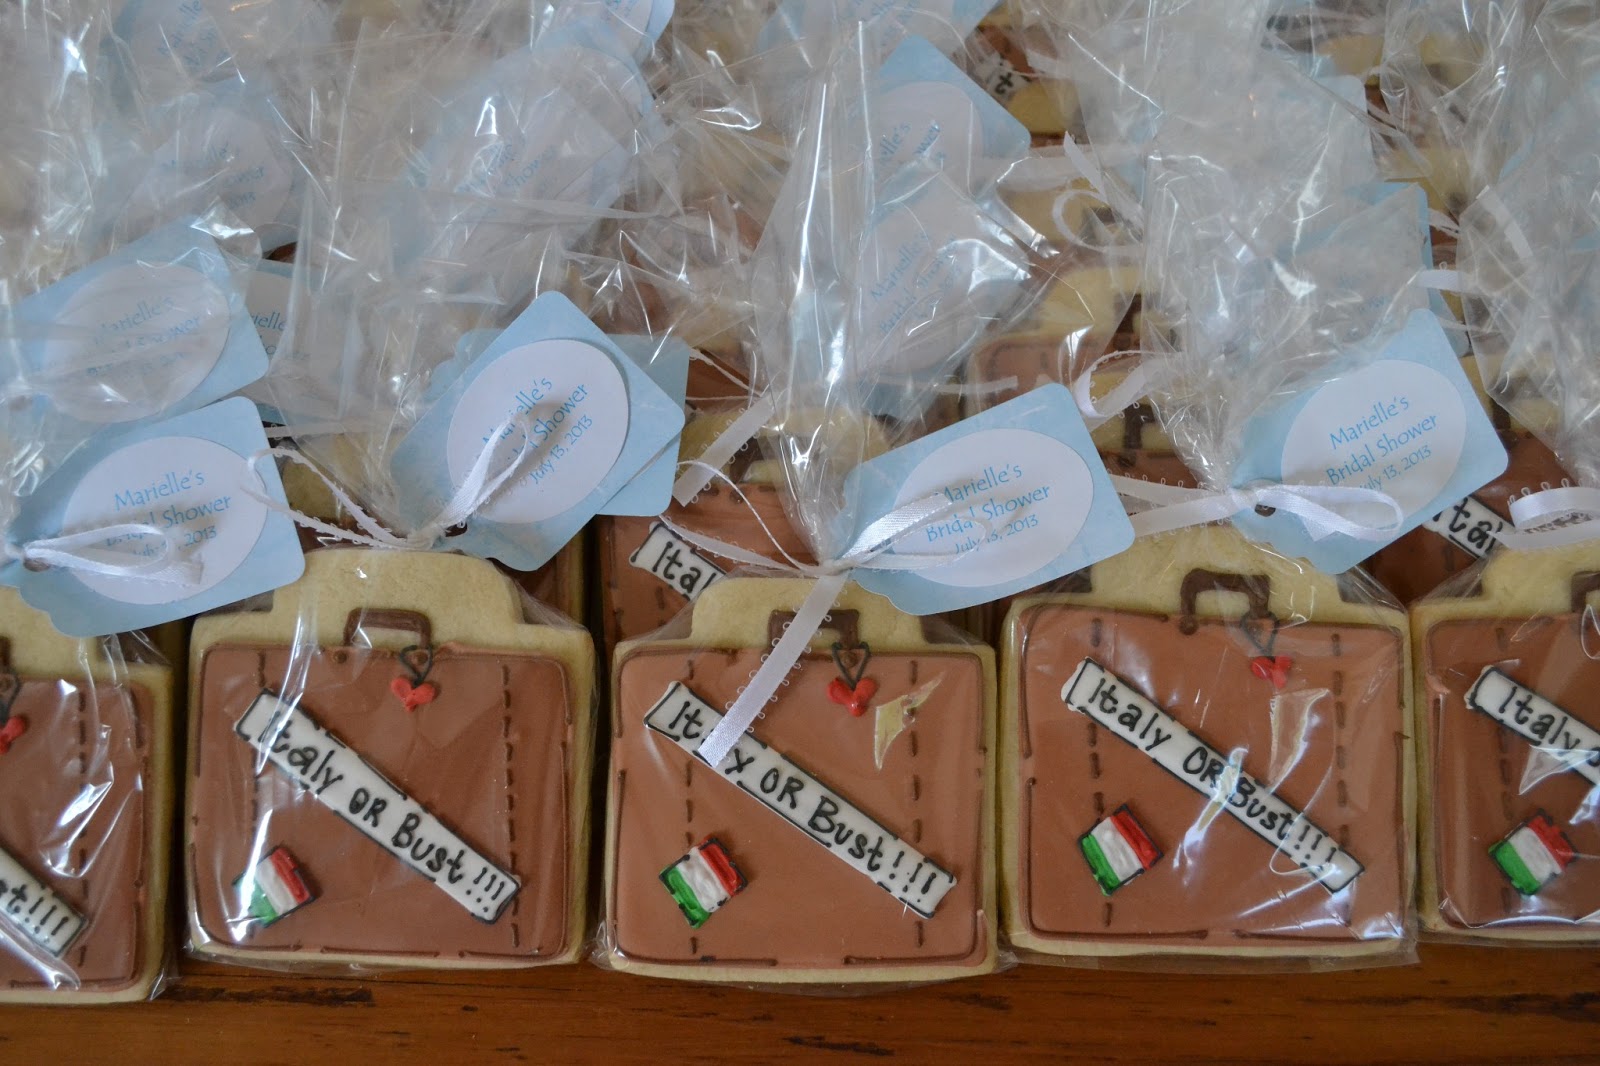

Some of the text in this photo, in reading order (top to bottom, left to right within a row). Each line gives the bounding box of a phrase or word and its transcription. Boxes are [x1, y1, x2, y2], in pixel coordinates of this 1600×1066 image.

[533, 383, 589, 442] Shower
[1329, 396, 1410, 450] Marielle's
[530, 457, 556, 485] July
[564, 414, 593, 446] 2013
[1325, 415, 1438, 486] Bridal Shower
[1358, 473, 1383, 492] uly
[1400, 444, 1432, 471] 2013
[113, 469, 206, 511] Marielle's
[162, 495, 232, 529] Shower
[981, 485, 1051, 522] Shower
[183, 525, 218, 548] 2013
[1006, 514, 1040, 537] 2013
[651, 541, 718, 594] Ital
[1088, 677, 1172, 752] Italy
[668, 700, 755, 774] Ity
[759, 767, 805, 810] OR
[349, 787, 387, 828] OR
